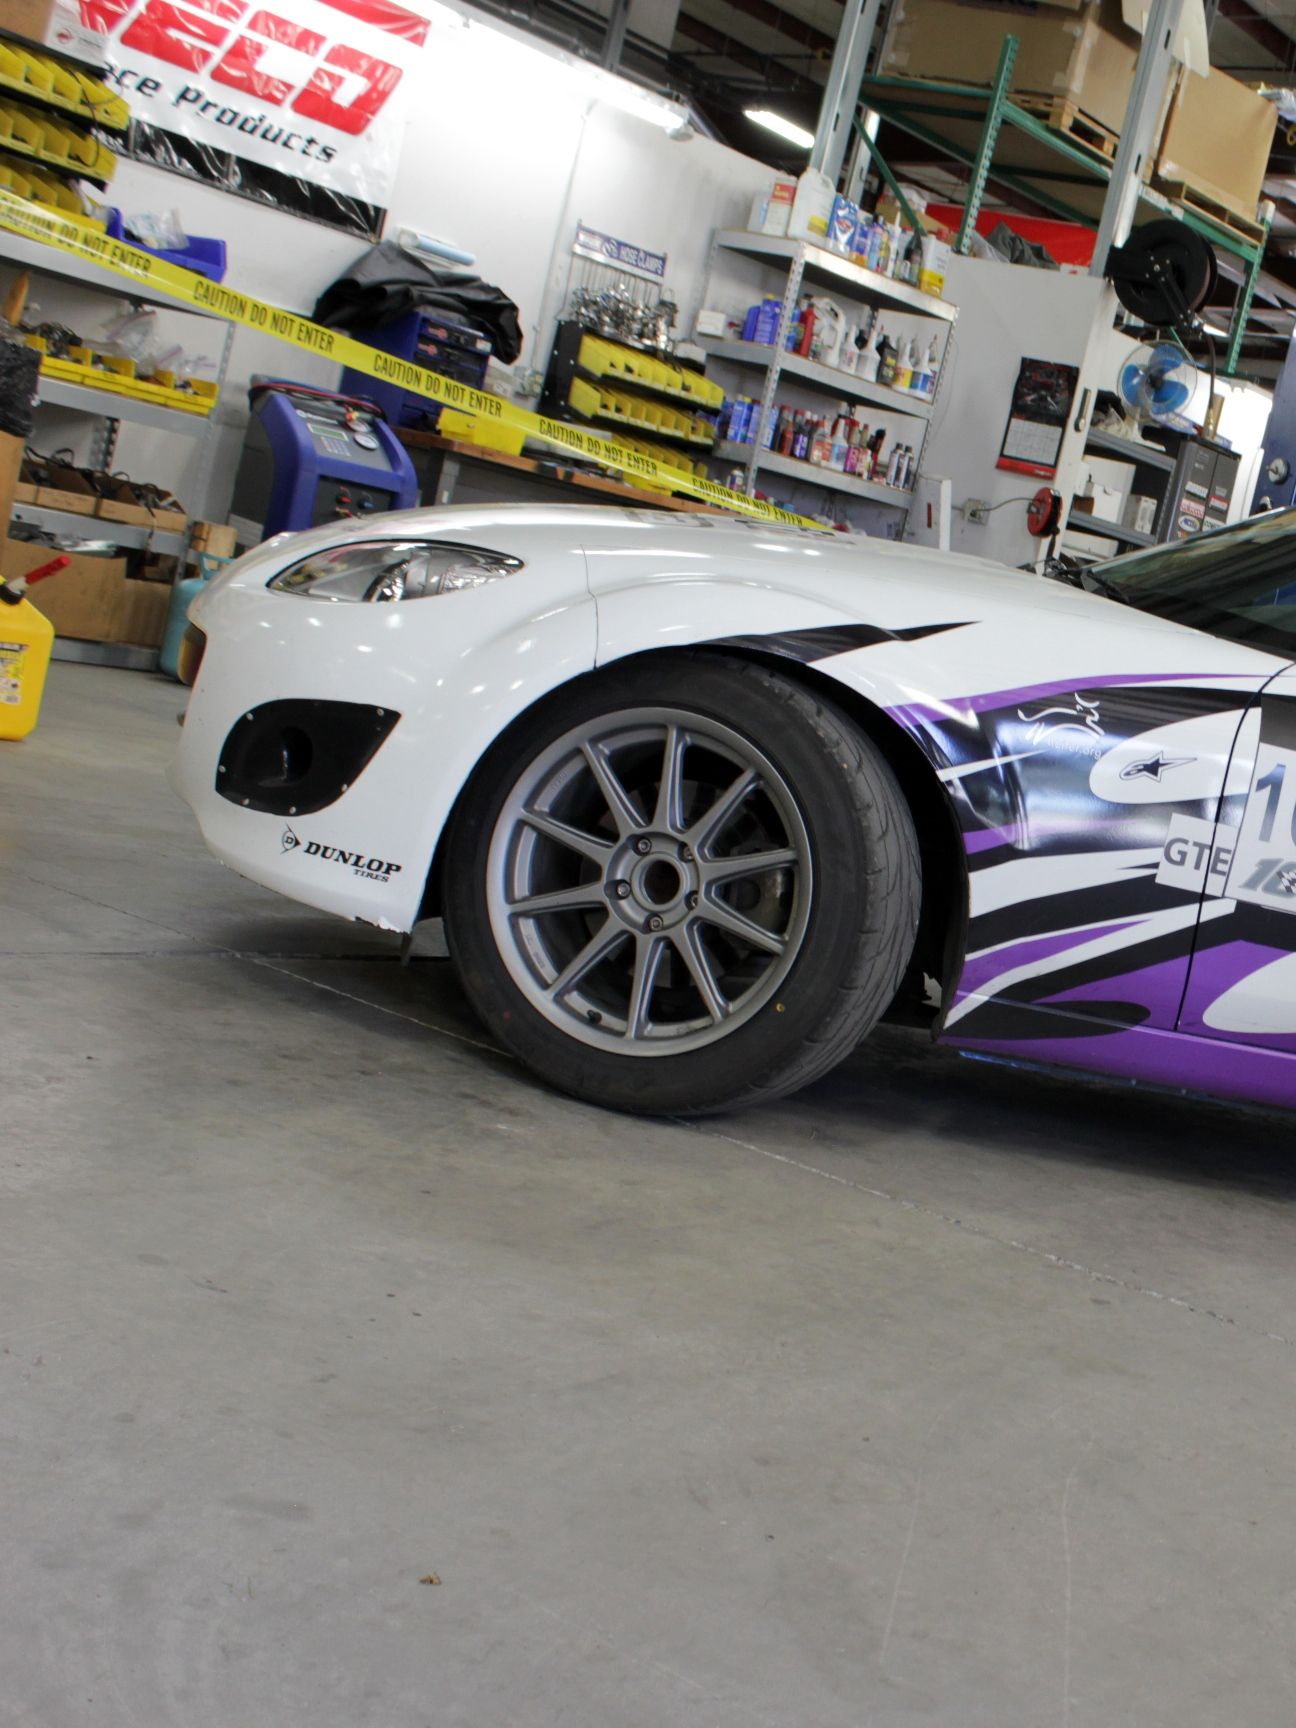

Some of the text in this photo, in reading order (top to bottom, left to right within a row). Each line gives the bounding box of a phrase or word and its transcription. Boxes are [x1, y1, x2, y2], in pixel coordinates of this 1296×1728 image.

[175, 84, 339, 164] Products
[60, 224, 77, 247] DO
[81, 231, 105, 260] NOT
[108, 242, 152, 277] ENTER
[193, 280, 335, 354] CAUTION DO NOT ENTER
[373, 353, 503, 418] CAUTION DO NOT ENTER
[539, 419, 659, 477] CAUTION DO NOT ENTER
[692, 477, 736, 506] CAUTION
[304, 841, 402, 876] DUNLOP
[353, 868, 390, 883] TIRES
[1164, 837, 1232, 876] GTE
